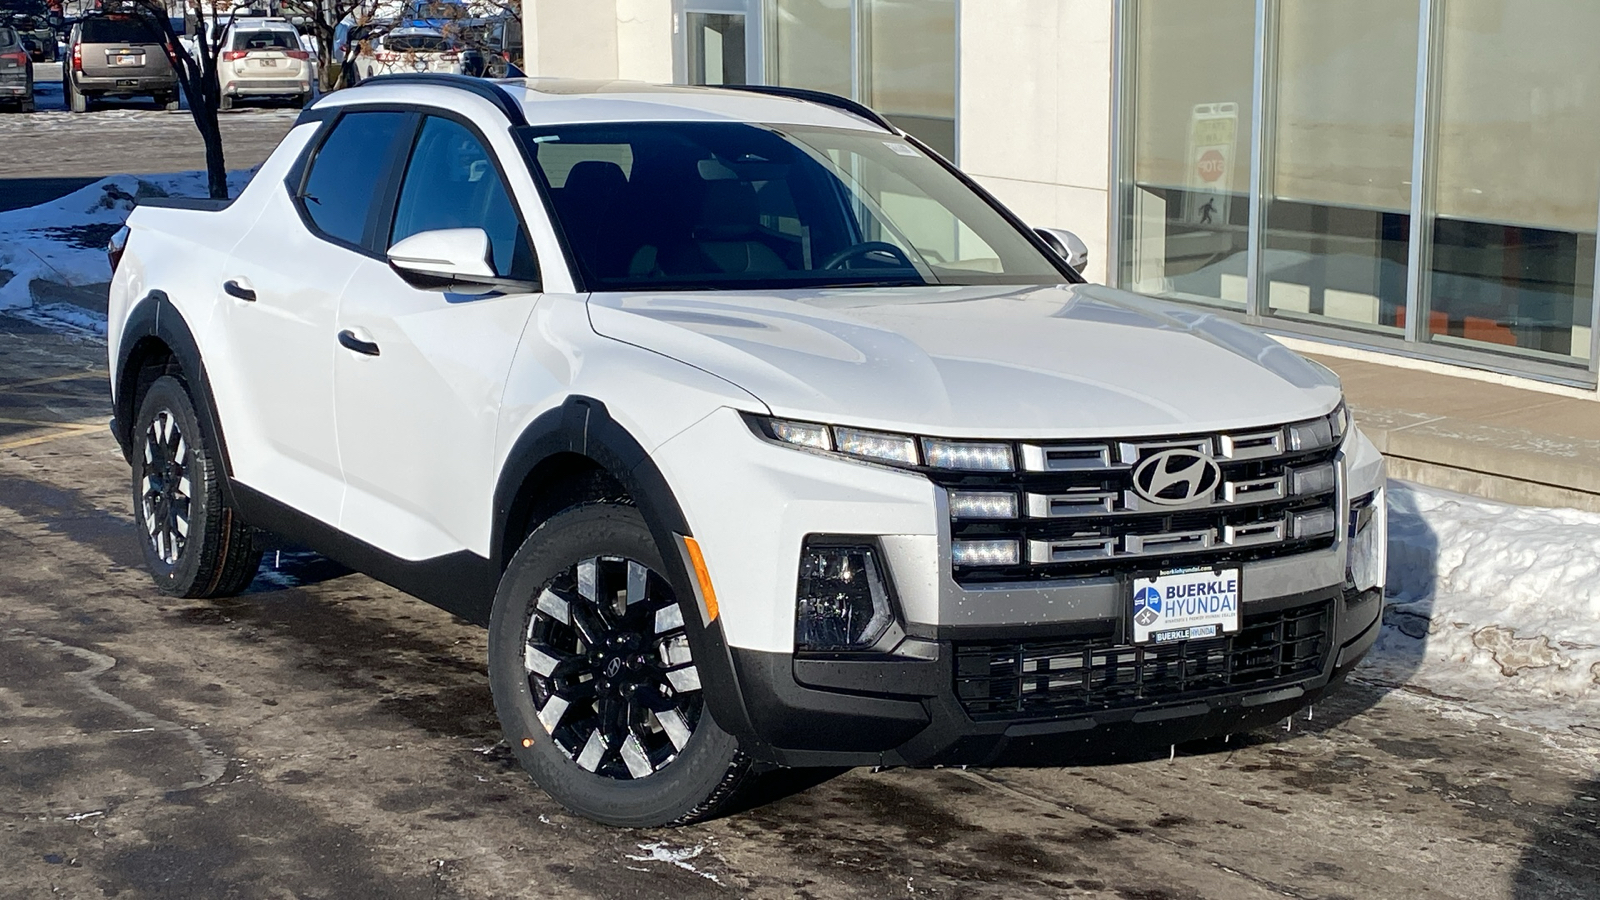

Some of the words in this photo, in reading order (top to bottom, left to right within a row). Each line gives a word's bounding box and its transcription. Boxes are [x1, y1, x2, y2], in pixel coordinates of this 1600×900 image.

[1166, 580, 1236, 599] BUERKLE
[1165, 594, 1236, 618] HYUNDAI
[1156, 630, 1190, 641] BUERKLE
[1190, 627, 1215, 637] HYUNDAI
